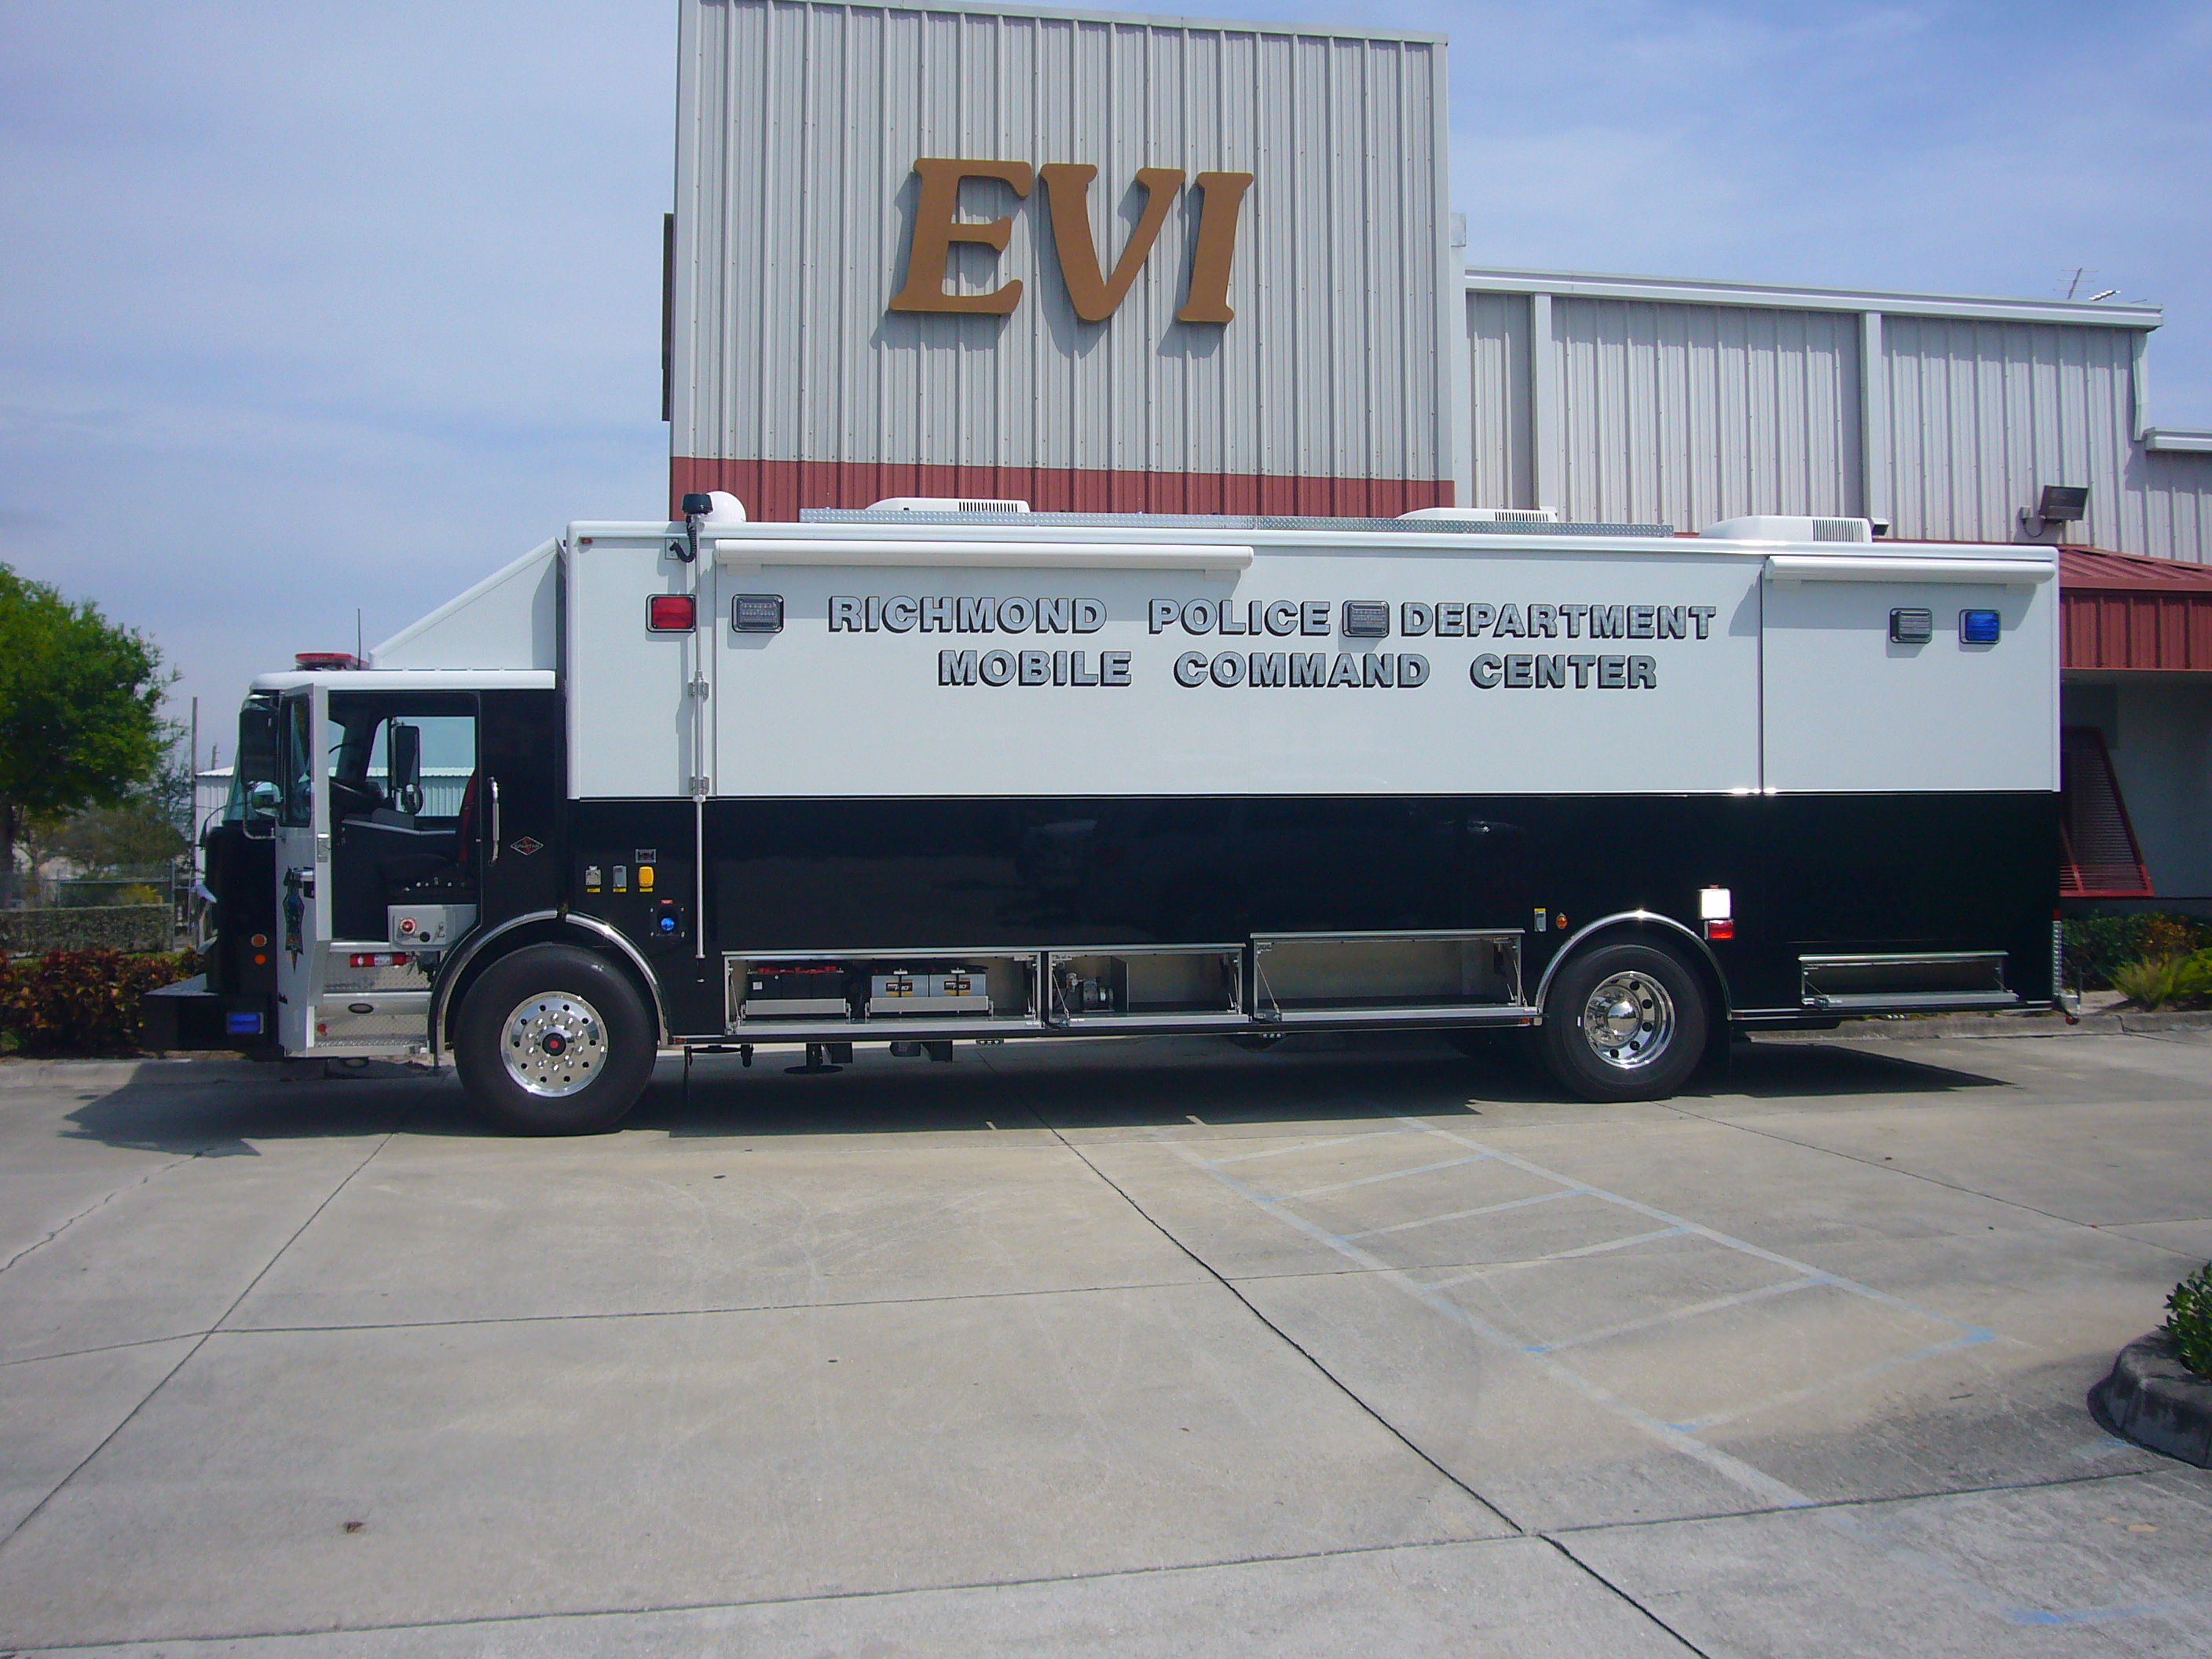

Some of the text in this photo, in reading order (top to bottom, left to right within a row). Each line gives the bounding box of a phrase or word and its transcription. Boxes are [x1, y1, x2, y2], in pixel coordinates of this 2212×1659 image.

[889, 158, 1254, 323] EVI
[829, 595, 1716, 639] RICHMOND POLICE DEPARTMENT
[938, 650, 1657, 690] MOBILE COMMAND CENTER
